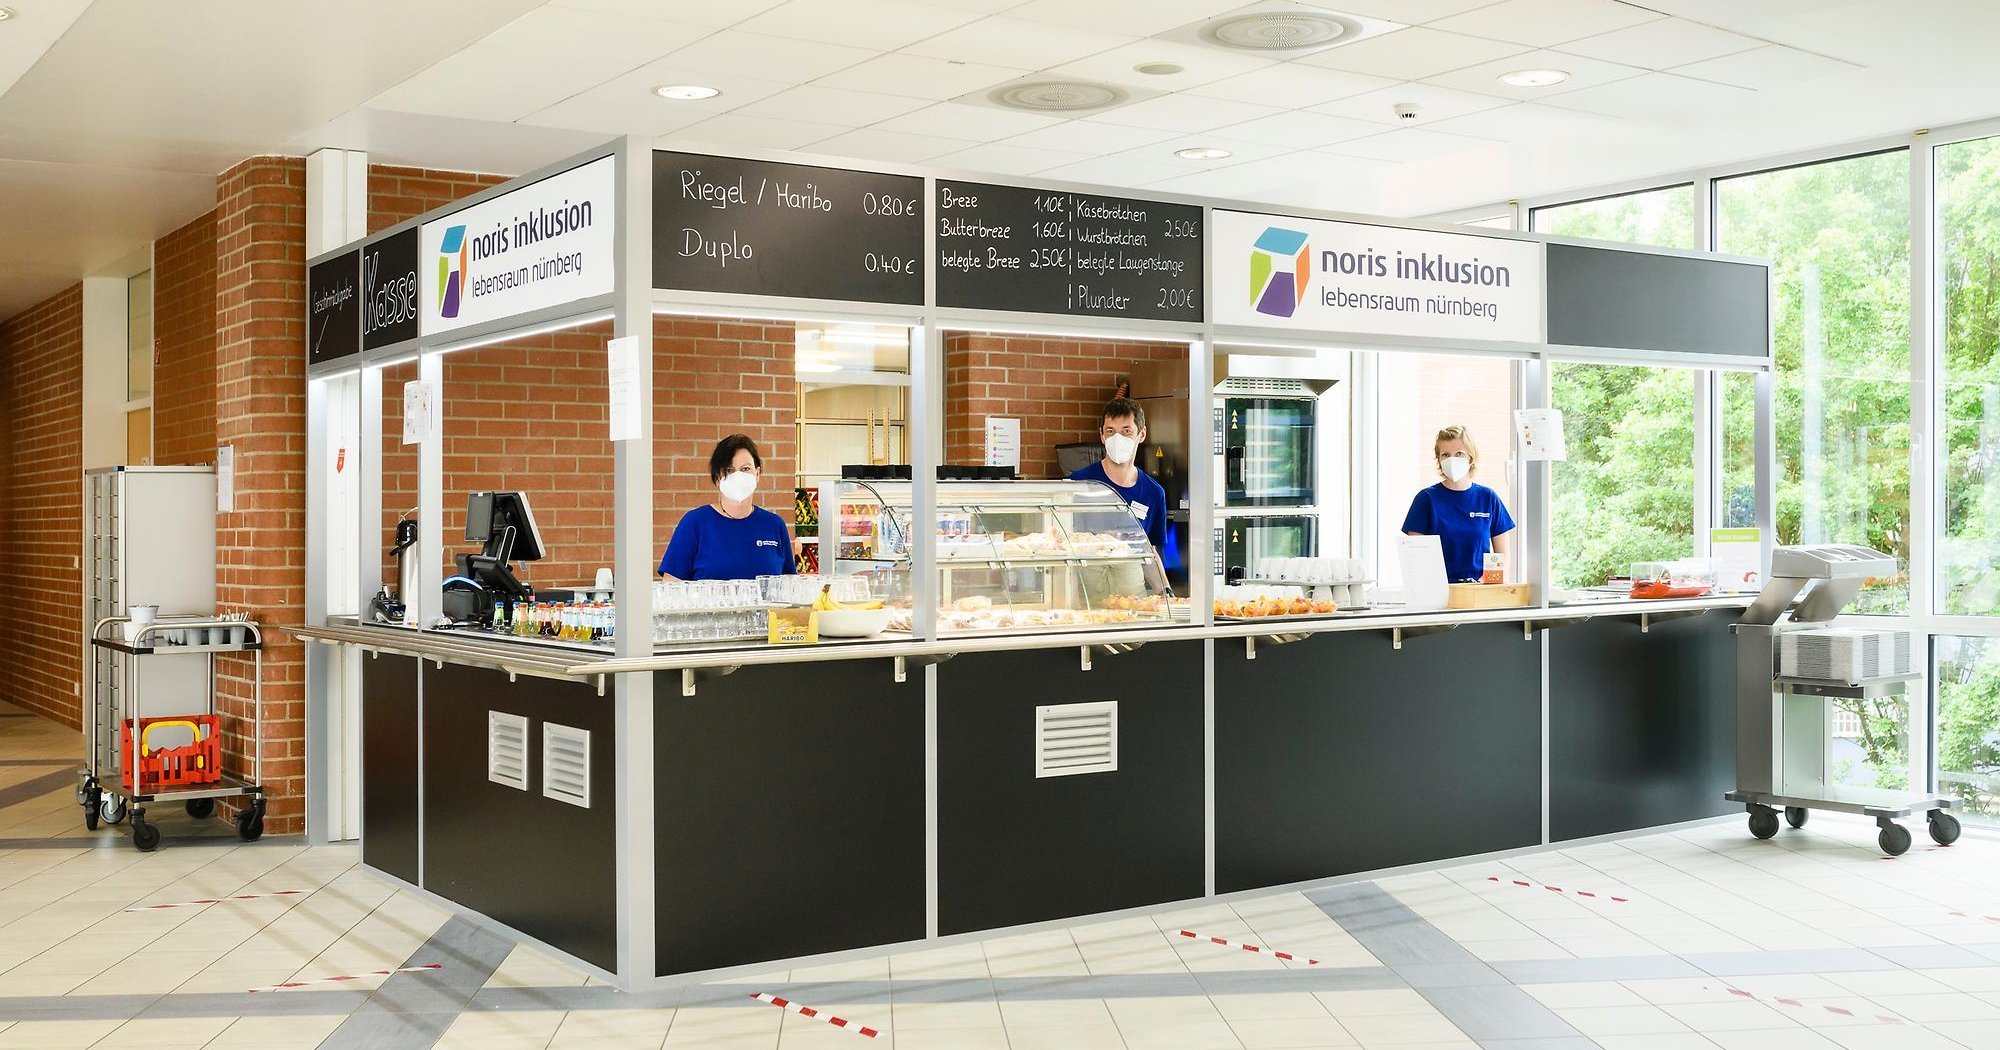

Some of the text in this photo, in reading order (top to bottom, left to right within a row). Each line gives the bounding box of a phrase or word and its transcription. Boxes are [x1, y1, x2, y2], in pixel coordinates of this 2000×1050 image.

[680, 170, 747, 208] Riegel
[775, 183, 832, 212] Haribo
[942, 188, 978, 209] Breze
[940, 218, 1011, 239] Butterbreze
[1077, 199, 1147, 222] Käsebrötchen
[473, 200, 592, 261] noris inklusion
[678, 228, 752, 268] Duplo
[472, 252, 582, 298] lebensraum nürnberg
[942, 249, 981, 273] belegte
[986, 247, 1020, 269] Breze
[1077, 250, 1185, 277] belegte Laugenstange
[1322, 247, 1511, 288] noris inklusion
[364, 251, 417, 335] Kasse
[1078, 285, 1130, 310] Plunder
[1321, 286, 1497, 322] lebensraum nürnberg
